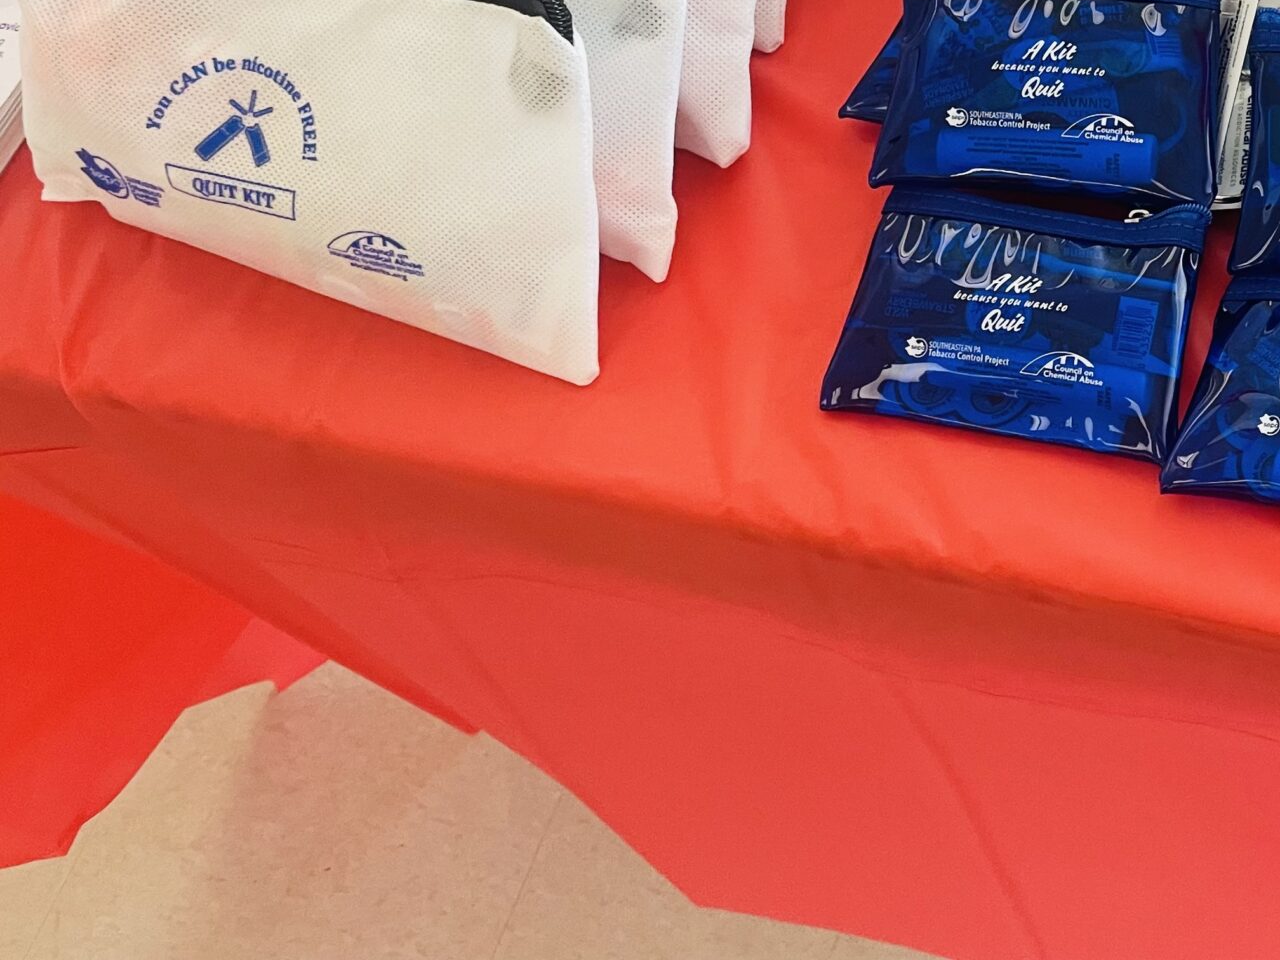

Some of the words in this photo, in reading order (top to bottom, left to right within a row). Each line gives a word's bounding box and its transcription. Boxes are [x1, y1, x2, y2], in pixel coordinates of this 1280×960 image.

[1021, 40, 1041, 61] A
[1042, 40, 1077, 61] Kit
[991, 62, 1036, 74] because
[1039, 64, 1060, 77] you
[1062, 65, 1090, 76] want
[1093, 68, 1106, 77] to
[1021, 77, 1064, 99] Quit
[146, 95, 173, 131] You
[169, 59, 210, 97] CAN
[212, 56, 236, 74] be
[241, 55, 302, 103] nicotine
[298, 102, 318, 162] FREE!
[970, 118, 996, 128] Tobacco
[998, 120, 1024, 129] Control
[1026, 122, 1051, 132] Project
[1096, 126, 1121, 136] Council
[191, 177, 239, 201] QUIT
[242, 187, 276, 210] KIT
[987, 273, 1005, 291] A
[1006, 273, 1043, 294] Kit
[981, 308, 1026, 333] Quit
[929, 349, 955, 359] Tobacco
[957, 352, 983, 363] Control
[984, 355, 1010, 367] Project
